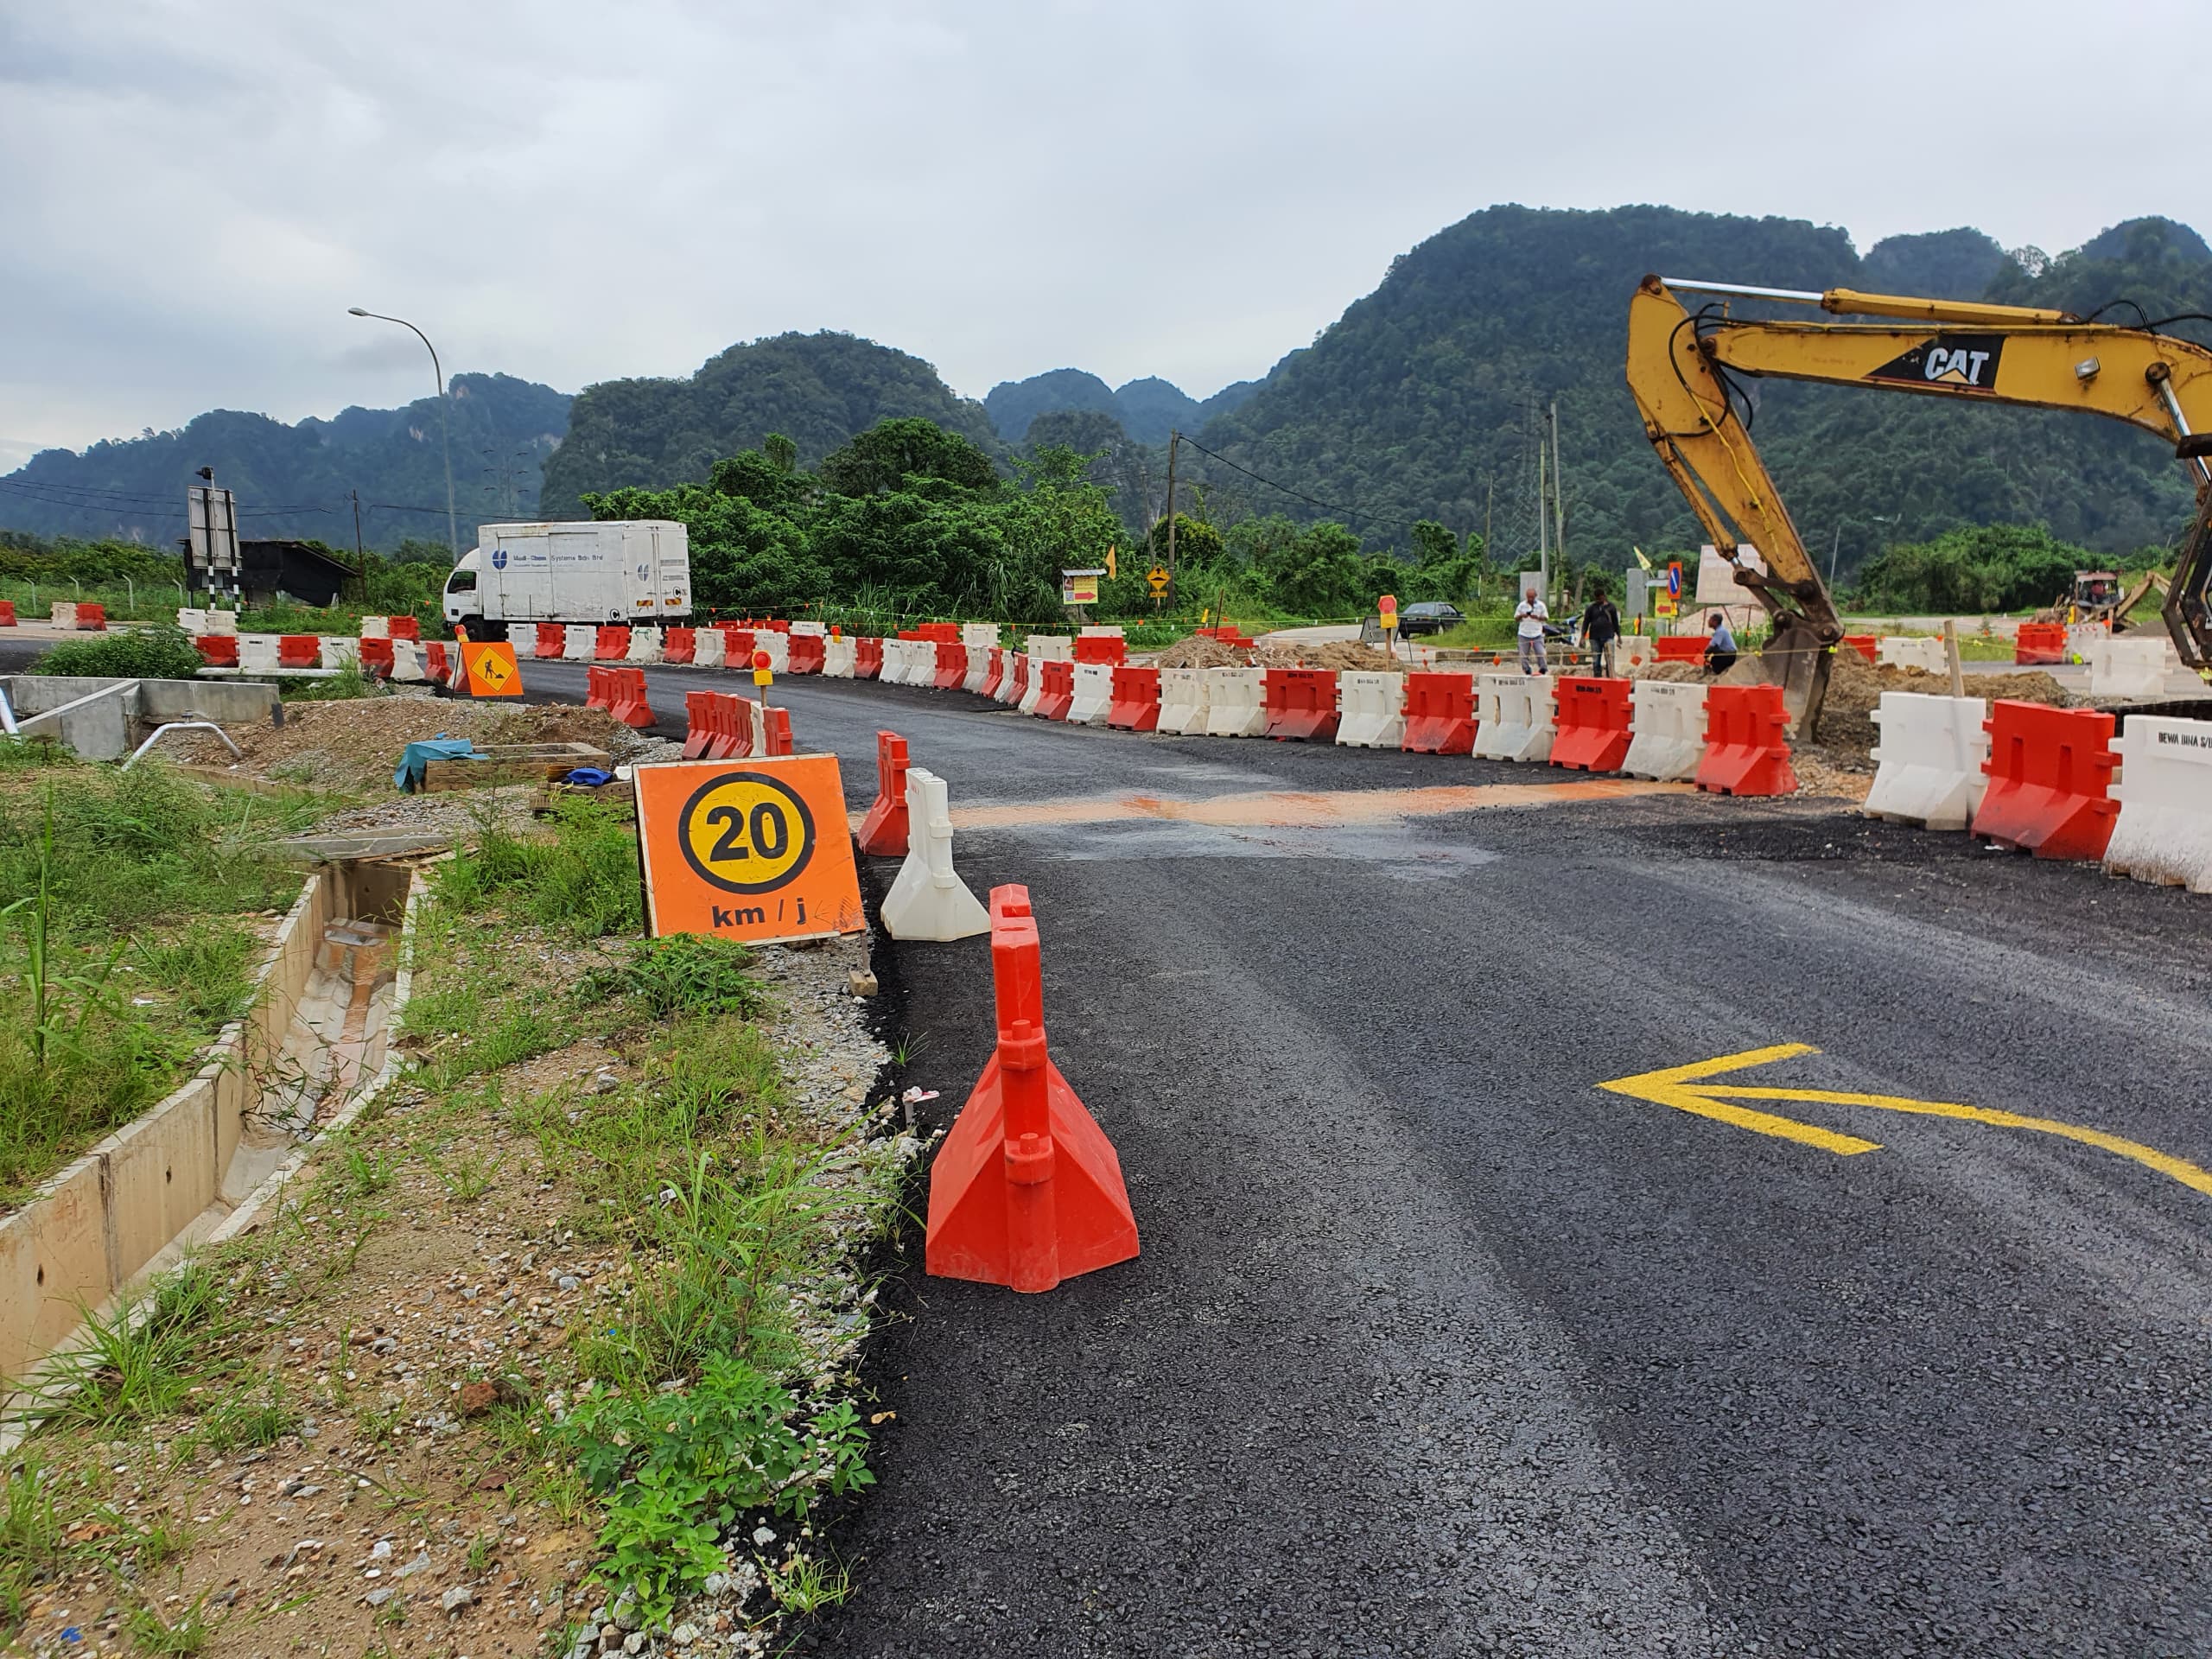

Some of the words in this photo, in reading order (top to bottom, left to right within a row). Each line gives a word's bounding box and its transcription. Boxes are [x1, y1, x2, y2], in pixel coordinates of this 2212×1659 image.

[1925, 347, 1989, 385] CAT
[706, 802, 789, 862] 20
[712, 906, 766, 928] km
[797, 897, 807, 925] j
